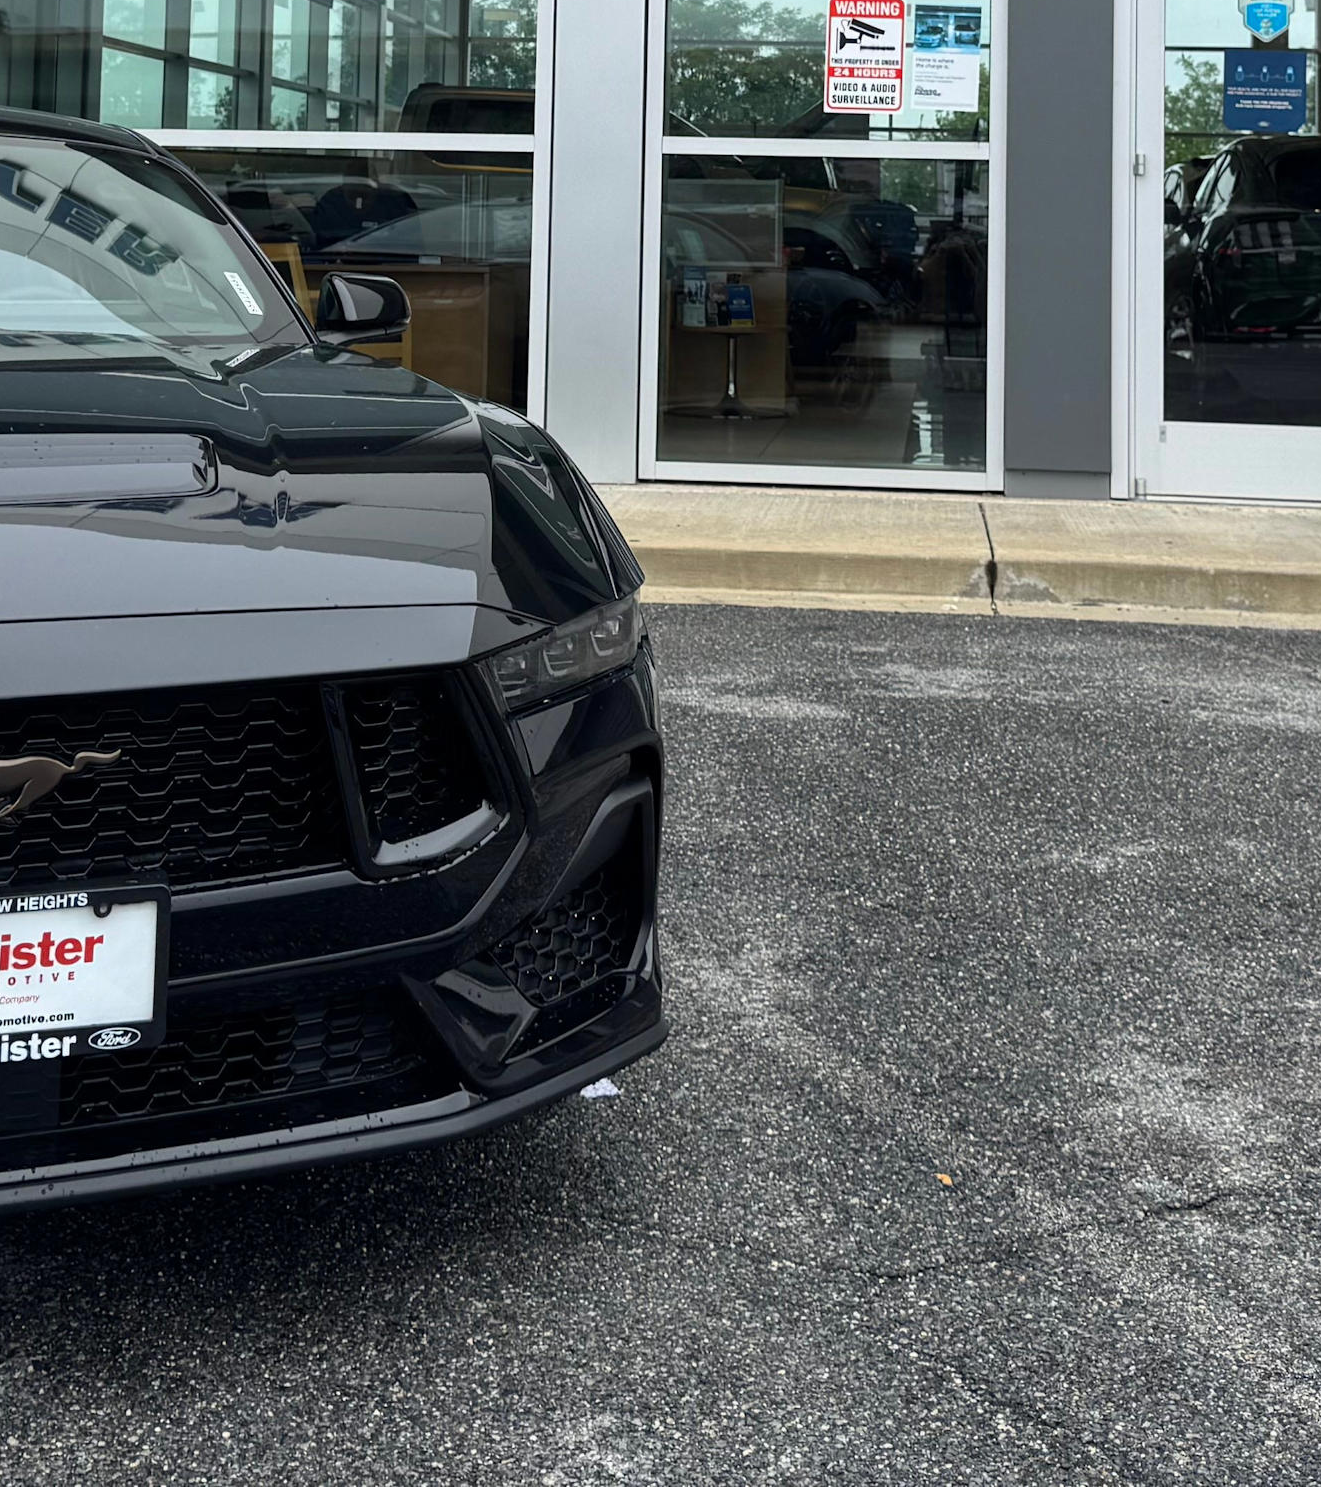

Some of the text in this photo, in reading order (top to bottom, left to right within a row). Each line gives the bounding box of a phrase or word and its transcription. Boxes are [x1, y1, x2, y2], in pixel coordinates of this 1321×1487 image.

[835, 1, 900, 16] WARNING
[834, 68, 897, 78] 24 HOURS
[833, 82, 896, 93] VIDEO & AUDIO
[832, 95, 896, 106] SURVEILLANCE
[16, 893, 89, 912] HEIGHTS
[0, 993, 40, 1007] Company
[95, 1028, 135, 1047] Ford
